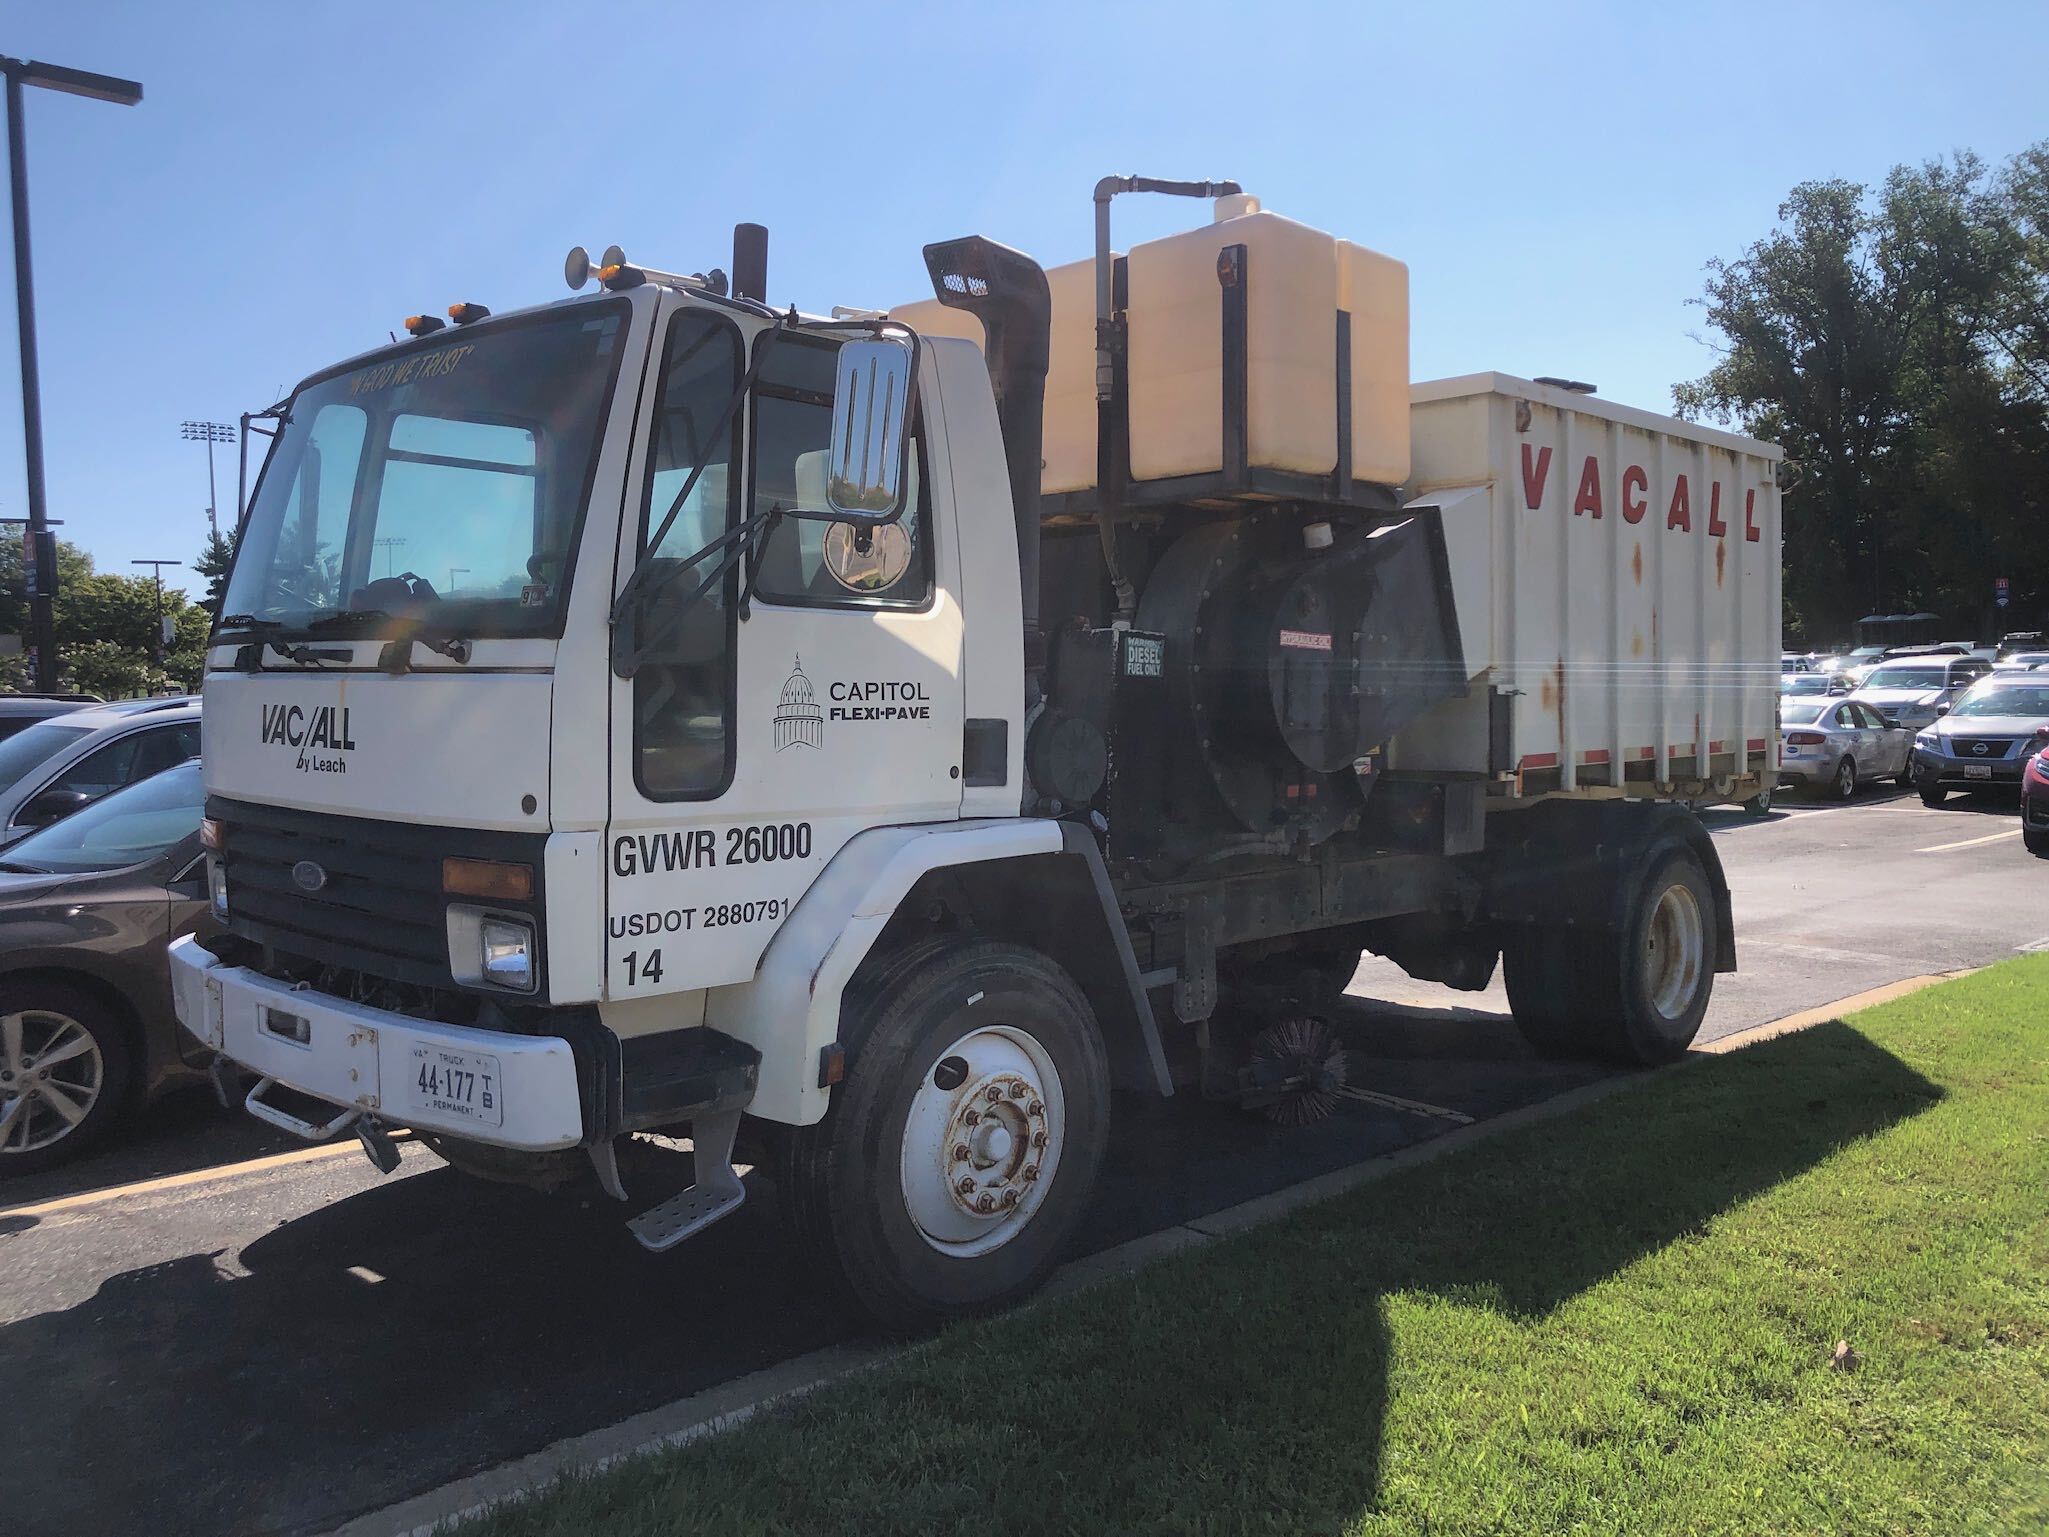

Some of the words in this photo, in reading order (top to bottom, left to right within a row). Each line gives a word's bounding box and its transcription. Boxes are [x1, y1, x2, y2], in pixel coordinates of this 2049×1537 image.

[392, 357, 420, 385] WE
[1521, 442, 1761, 543] VACALL
[1128, 646, 1161, 664] DIESEL
[1127, 662, 1144, 675] FUEL
[1144, 663, 1161, 676] ONLY
[829, 681, 930, 701] CAPITOL
[262, 703, 355, 751] VAC/ALL
[295, 747, 310, 773] by
[313, 755, 346, 773] Leach
[613, 830, 716, 877] GVWR
[726, 822, 812, 866] 26000
[609, 908, 697, 939] USDOT
[703, 898, 789, 928] 2880791
[622, 948, 664, 986] 14
[439, 1053, 465, 1066] TRUCK
[433, 1100, 474, 1116] PERMANENT
